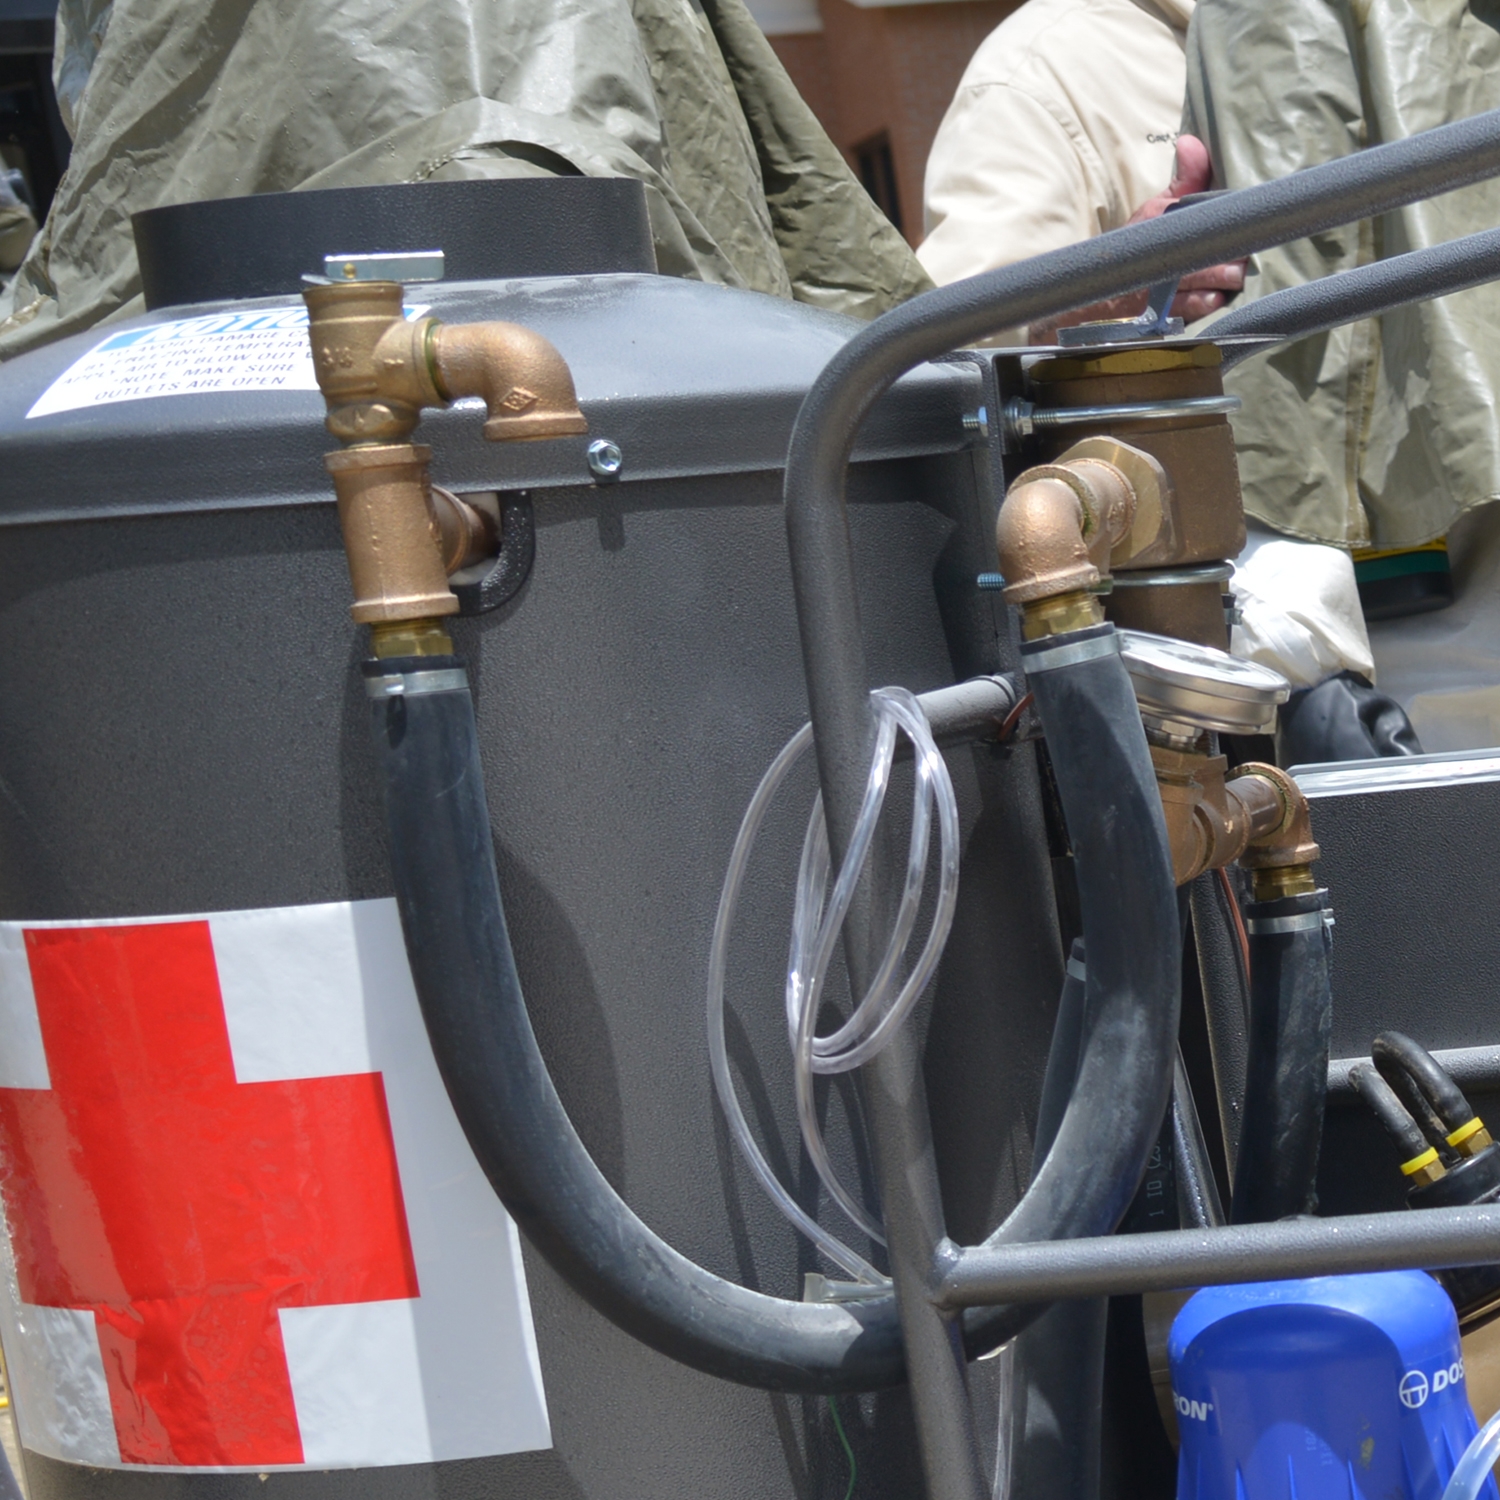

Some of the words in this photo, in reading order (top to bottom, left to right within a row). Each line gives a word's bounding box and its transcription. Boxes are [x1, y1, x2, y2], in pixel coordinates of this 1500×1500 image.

[132, 309, 310, 347] NOTIC
[200, 330, 282, 345] DAMAGE
[214, 339, 311, 353] TEMPERA
[193, 352, 253, 365] BLOW
[256, 351, 296, 361] OUT
[182, 365, 238, 378] MAKE
[244, 363, 297, 373] SURE
[93, 381, 182, 401] OUTLETS
[185, 377, 226, 389] ARE
[231, 375, 287, 387] OPEN
